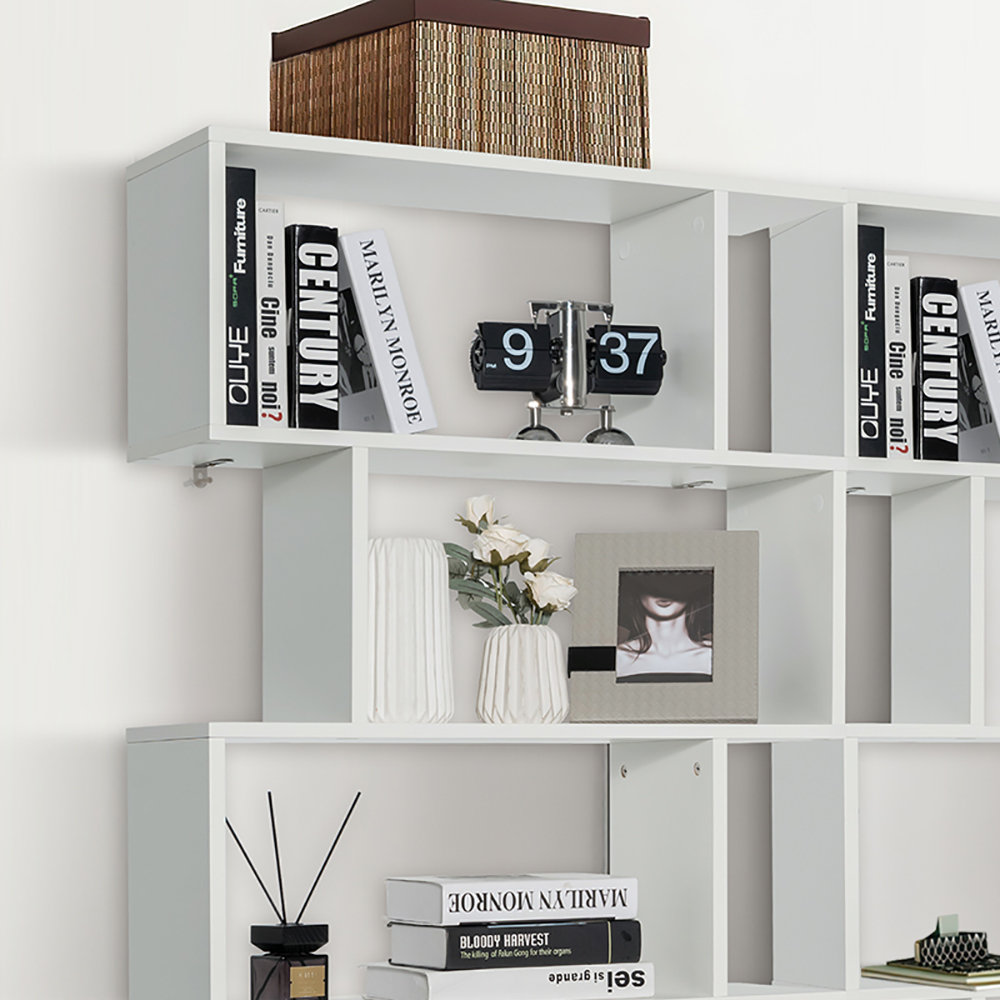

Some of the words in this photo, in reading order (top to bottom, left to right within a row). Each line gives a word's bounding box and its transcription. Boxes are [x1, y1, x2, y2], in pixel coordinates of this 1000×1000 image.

[233, 197, 247, 274] Furniture
[864, 252, 877, 321] Furniture
[261, 296, 280, 339] Cine
[298, 242, 339, 412] CENTURY
[359, 239, 398, 333] MARILYN
[385, 336, 423, 425] MONROE
[502, 328, 534, 371] 9
[599, 331, 659, 375] 37
[888, 341, 906, 380] Cine
[922, 292, 959, 445] CENTURY
[261, 381, 283, 422] noi?
[889, 417, 909, 454] noi?
[448, 890, 534, 913] MONROE
[539, 888, 629, 910] MARILYN
[460, 935, 501, 949] BLOODY
[504, 932, 550, 947] HARVEST
[460, 951, 471, 959] The
[471, 950, 489, 960] killing
[490, 950, 498, 958] of
[514, 949, 529, 959] Gong
[529, 948, 538, 956] for
[538, 948, 552, 956] their
[552, 949, 572, 957] organs
[548, 969, 591, 985] grande
[594, 971, 605, 983] si
[607, 970, 646, 993] sei
